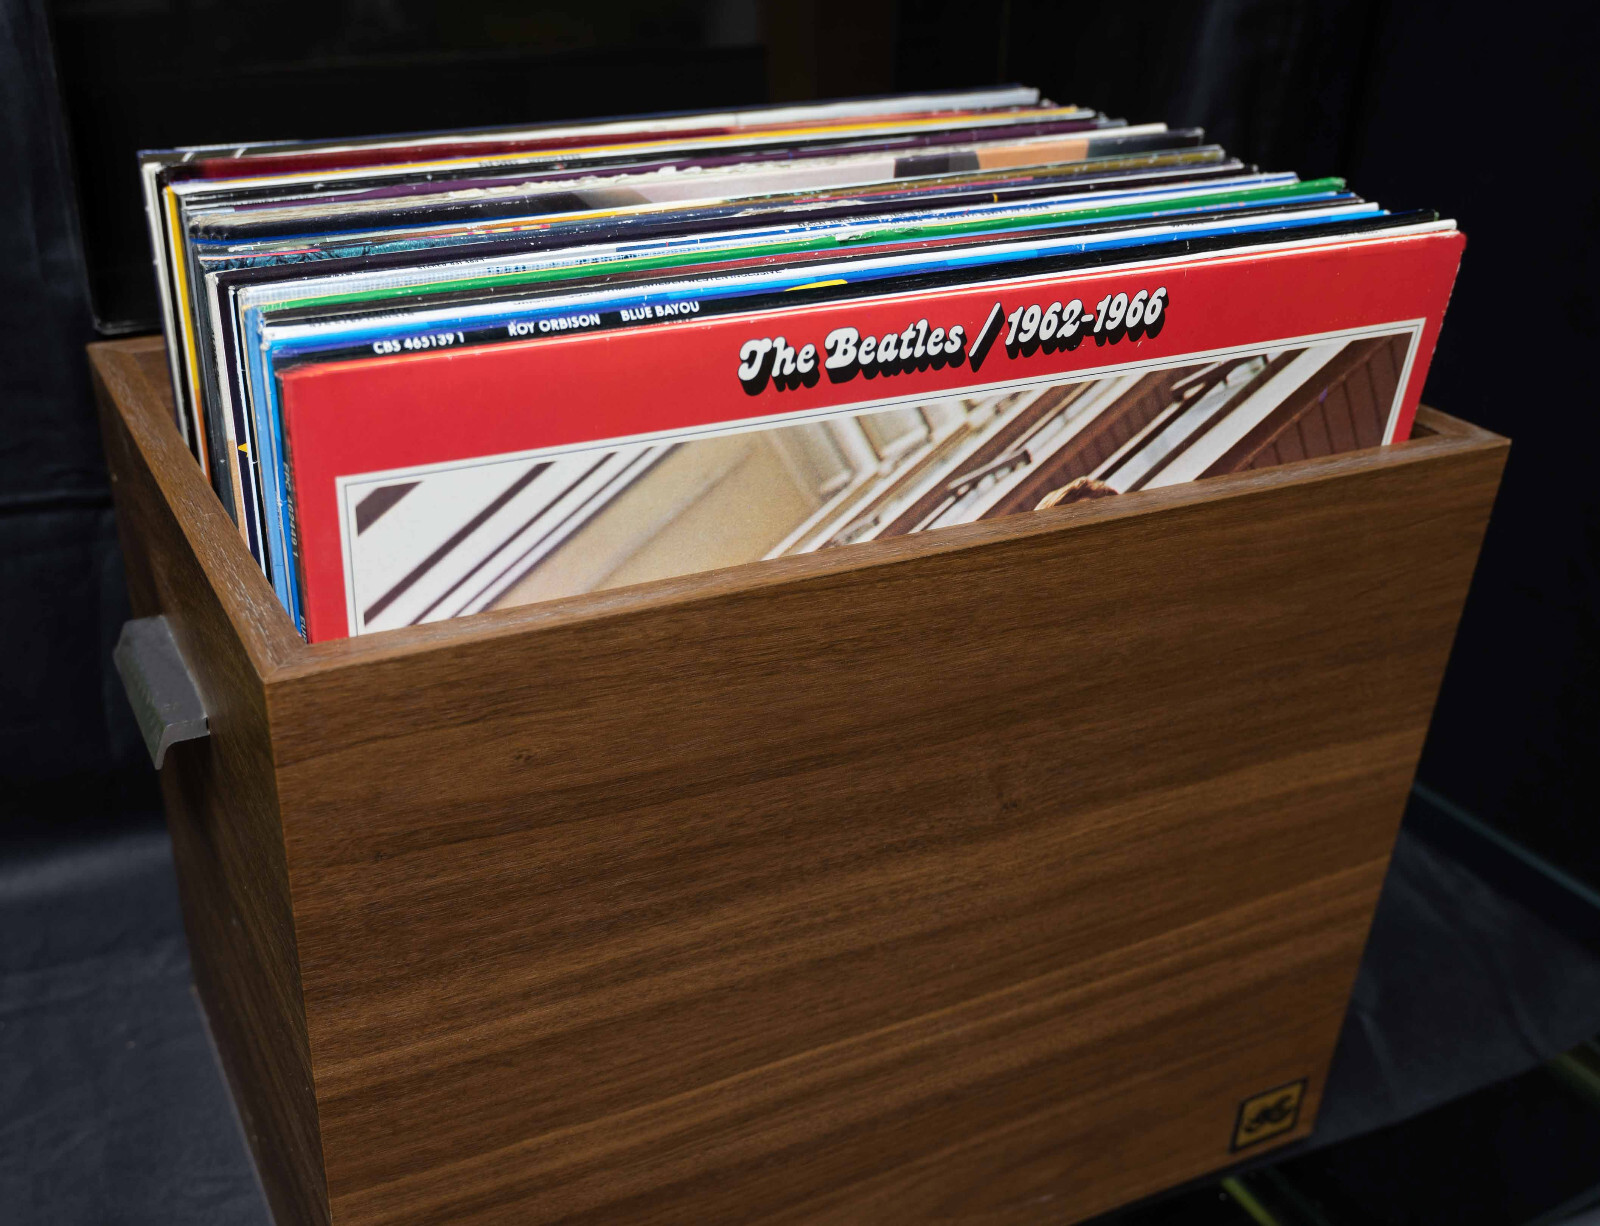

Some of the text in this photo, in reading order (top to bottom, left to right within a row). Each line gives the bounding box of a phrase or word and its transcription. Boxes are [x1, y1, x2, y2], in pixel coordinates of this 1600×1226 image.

[620, 300, 700, 322] BLUE BAYOU
[507, 313, 601, 337] ROY ORBISON
[373, 331, 465, 355] CBS 465139 1
[738, 336, 818, 390] The
[824, 318, 966, 377] Beatles
[1005, 286, 1168, 352] 1962-1966
